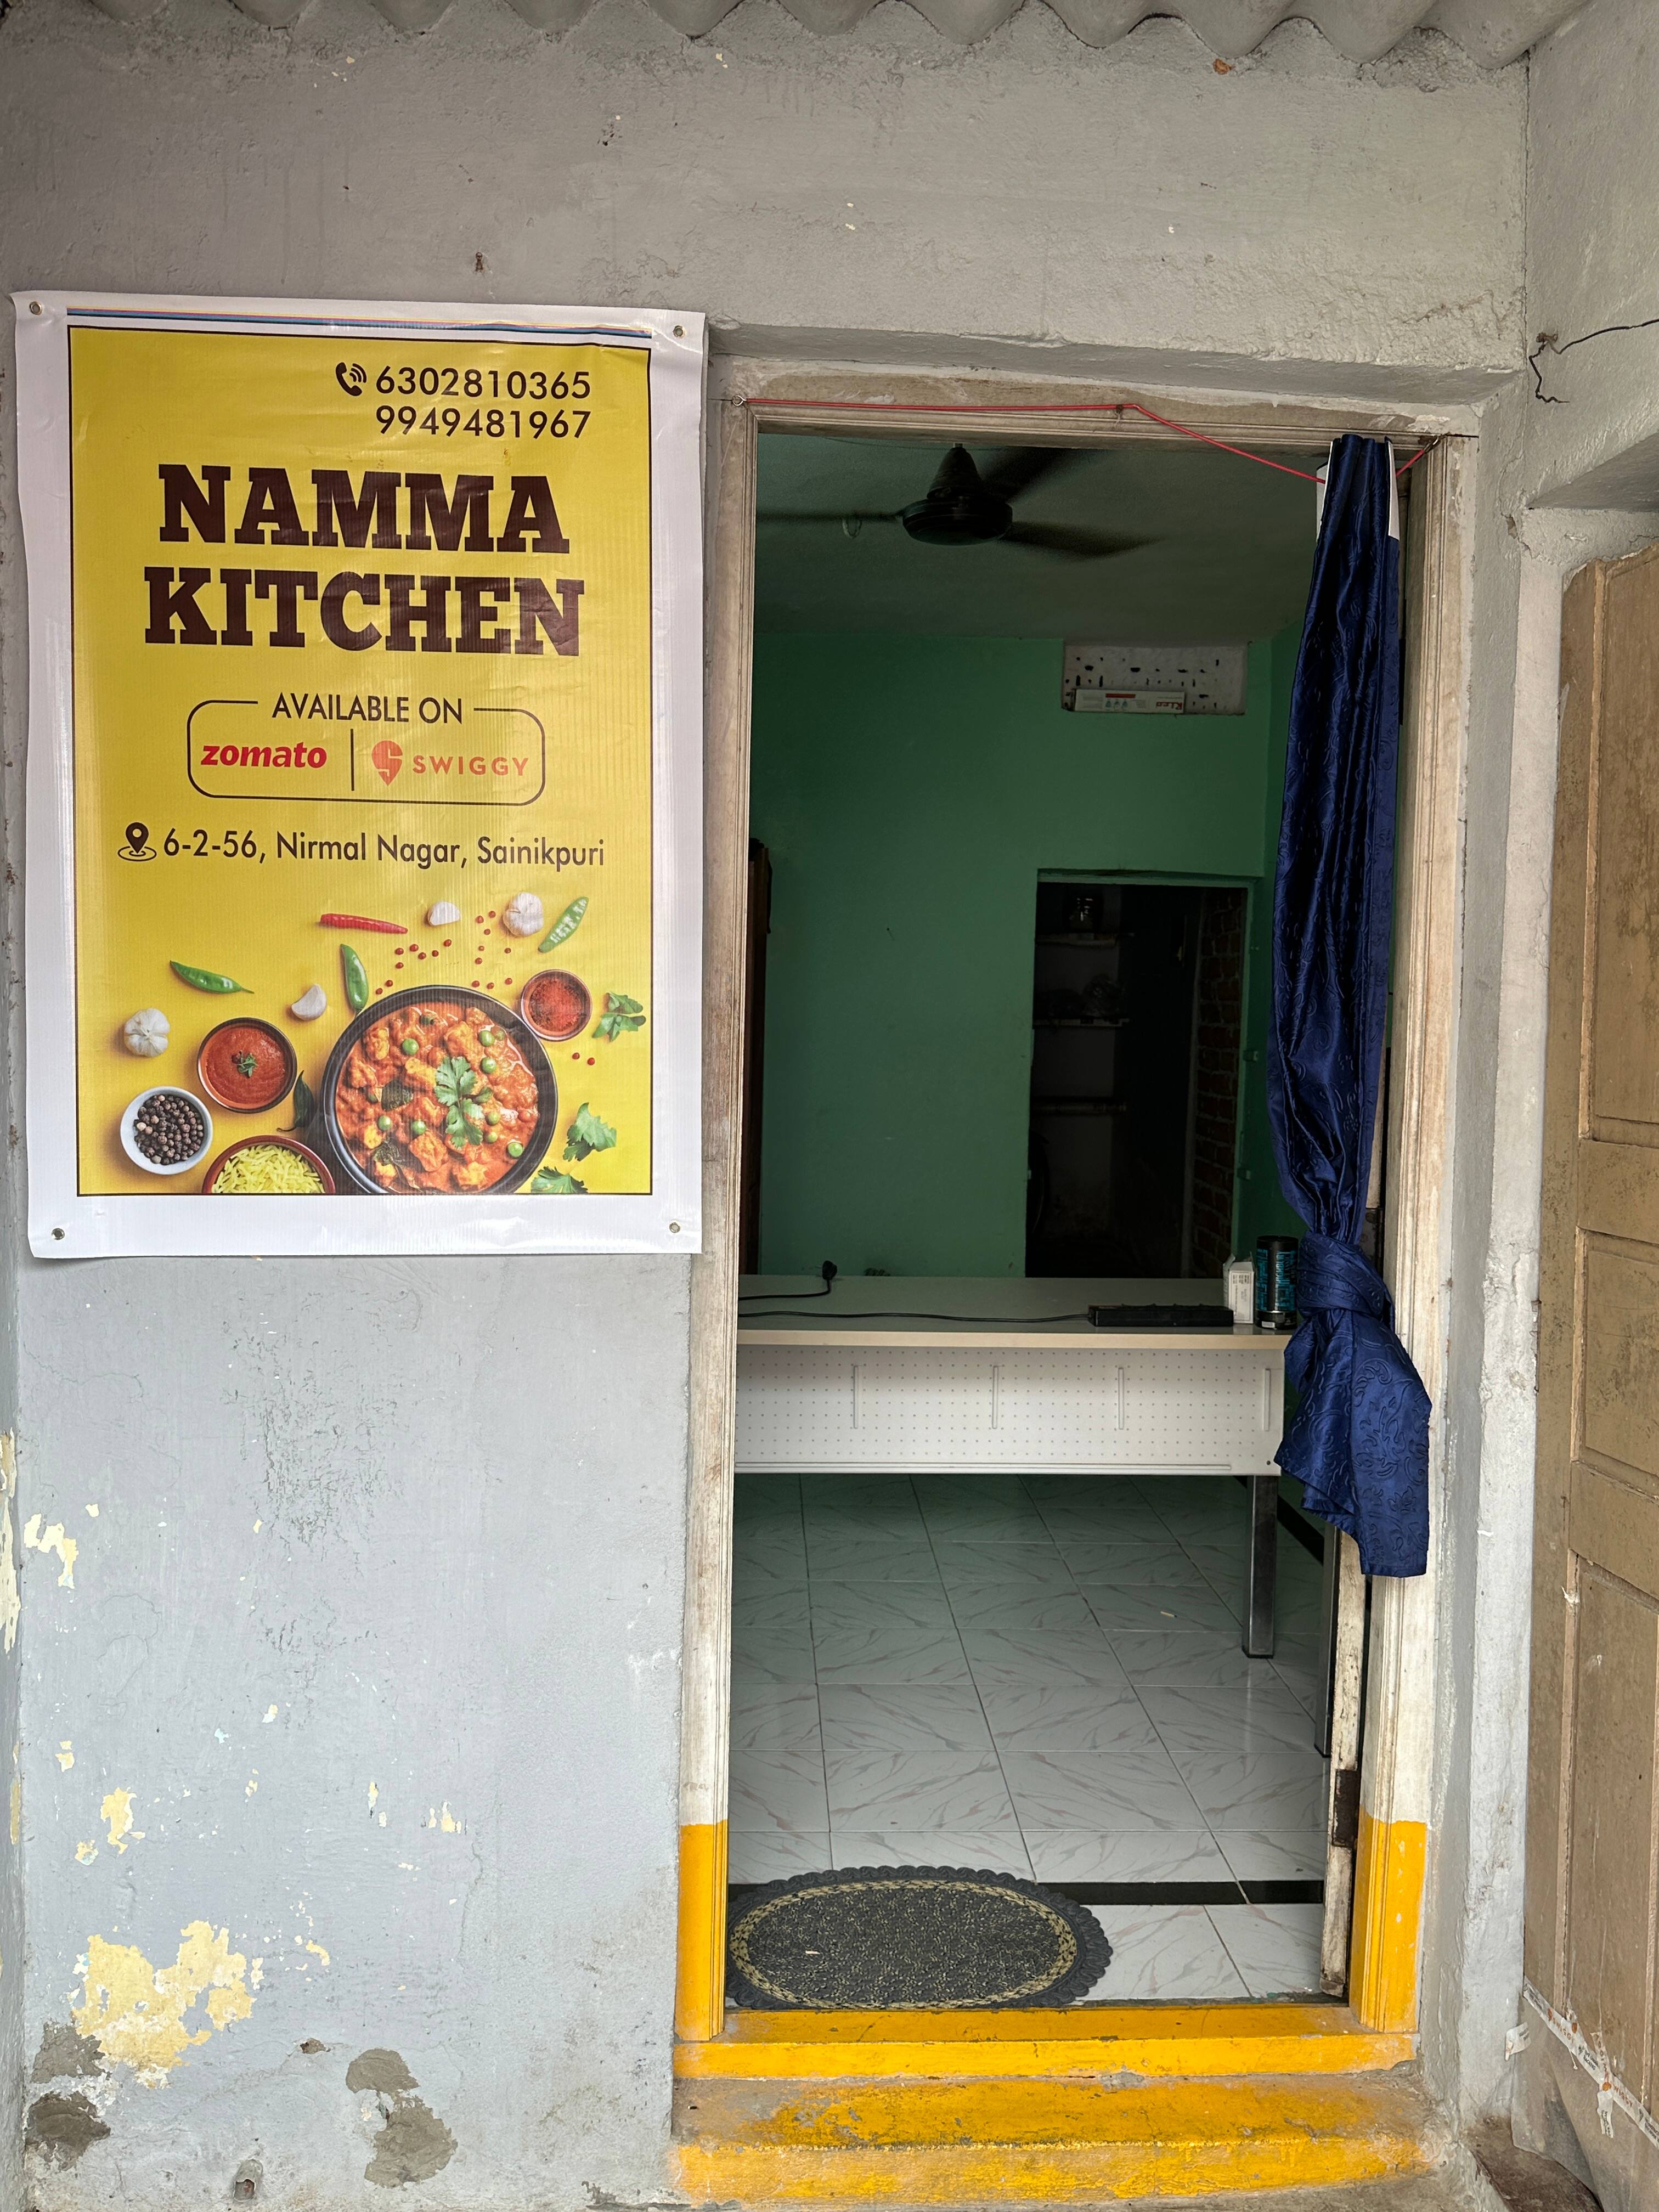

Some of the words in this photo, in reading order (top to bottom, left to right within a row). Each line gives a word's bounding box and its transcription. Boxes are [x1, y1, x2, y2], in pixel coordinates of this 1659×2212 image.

[375, 365, 591, 400] 6302810365
[375, 404, 592, 440] 9949481967
[157, 463, 570, 555] NAMMA
[143, 566, 585, 657] KITCHEN
[271, 691, 409, 723] AVAILABLE
[418, 697, 462, 725] ON
[200, 741, 329, 770] zomato
[411, 754, 530, 778] SWIGGY
[163, 827, 267, 865] 6-2-56,
[276, 830, 366, 861] Nirmal
[377, 833, 467, 870] Nagar,
[477, 836, 604, 872] Sainikpuri
